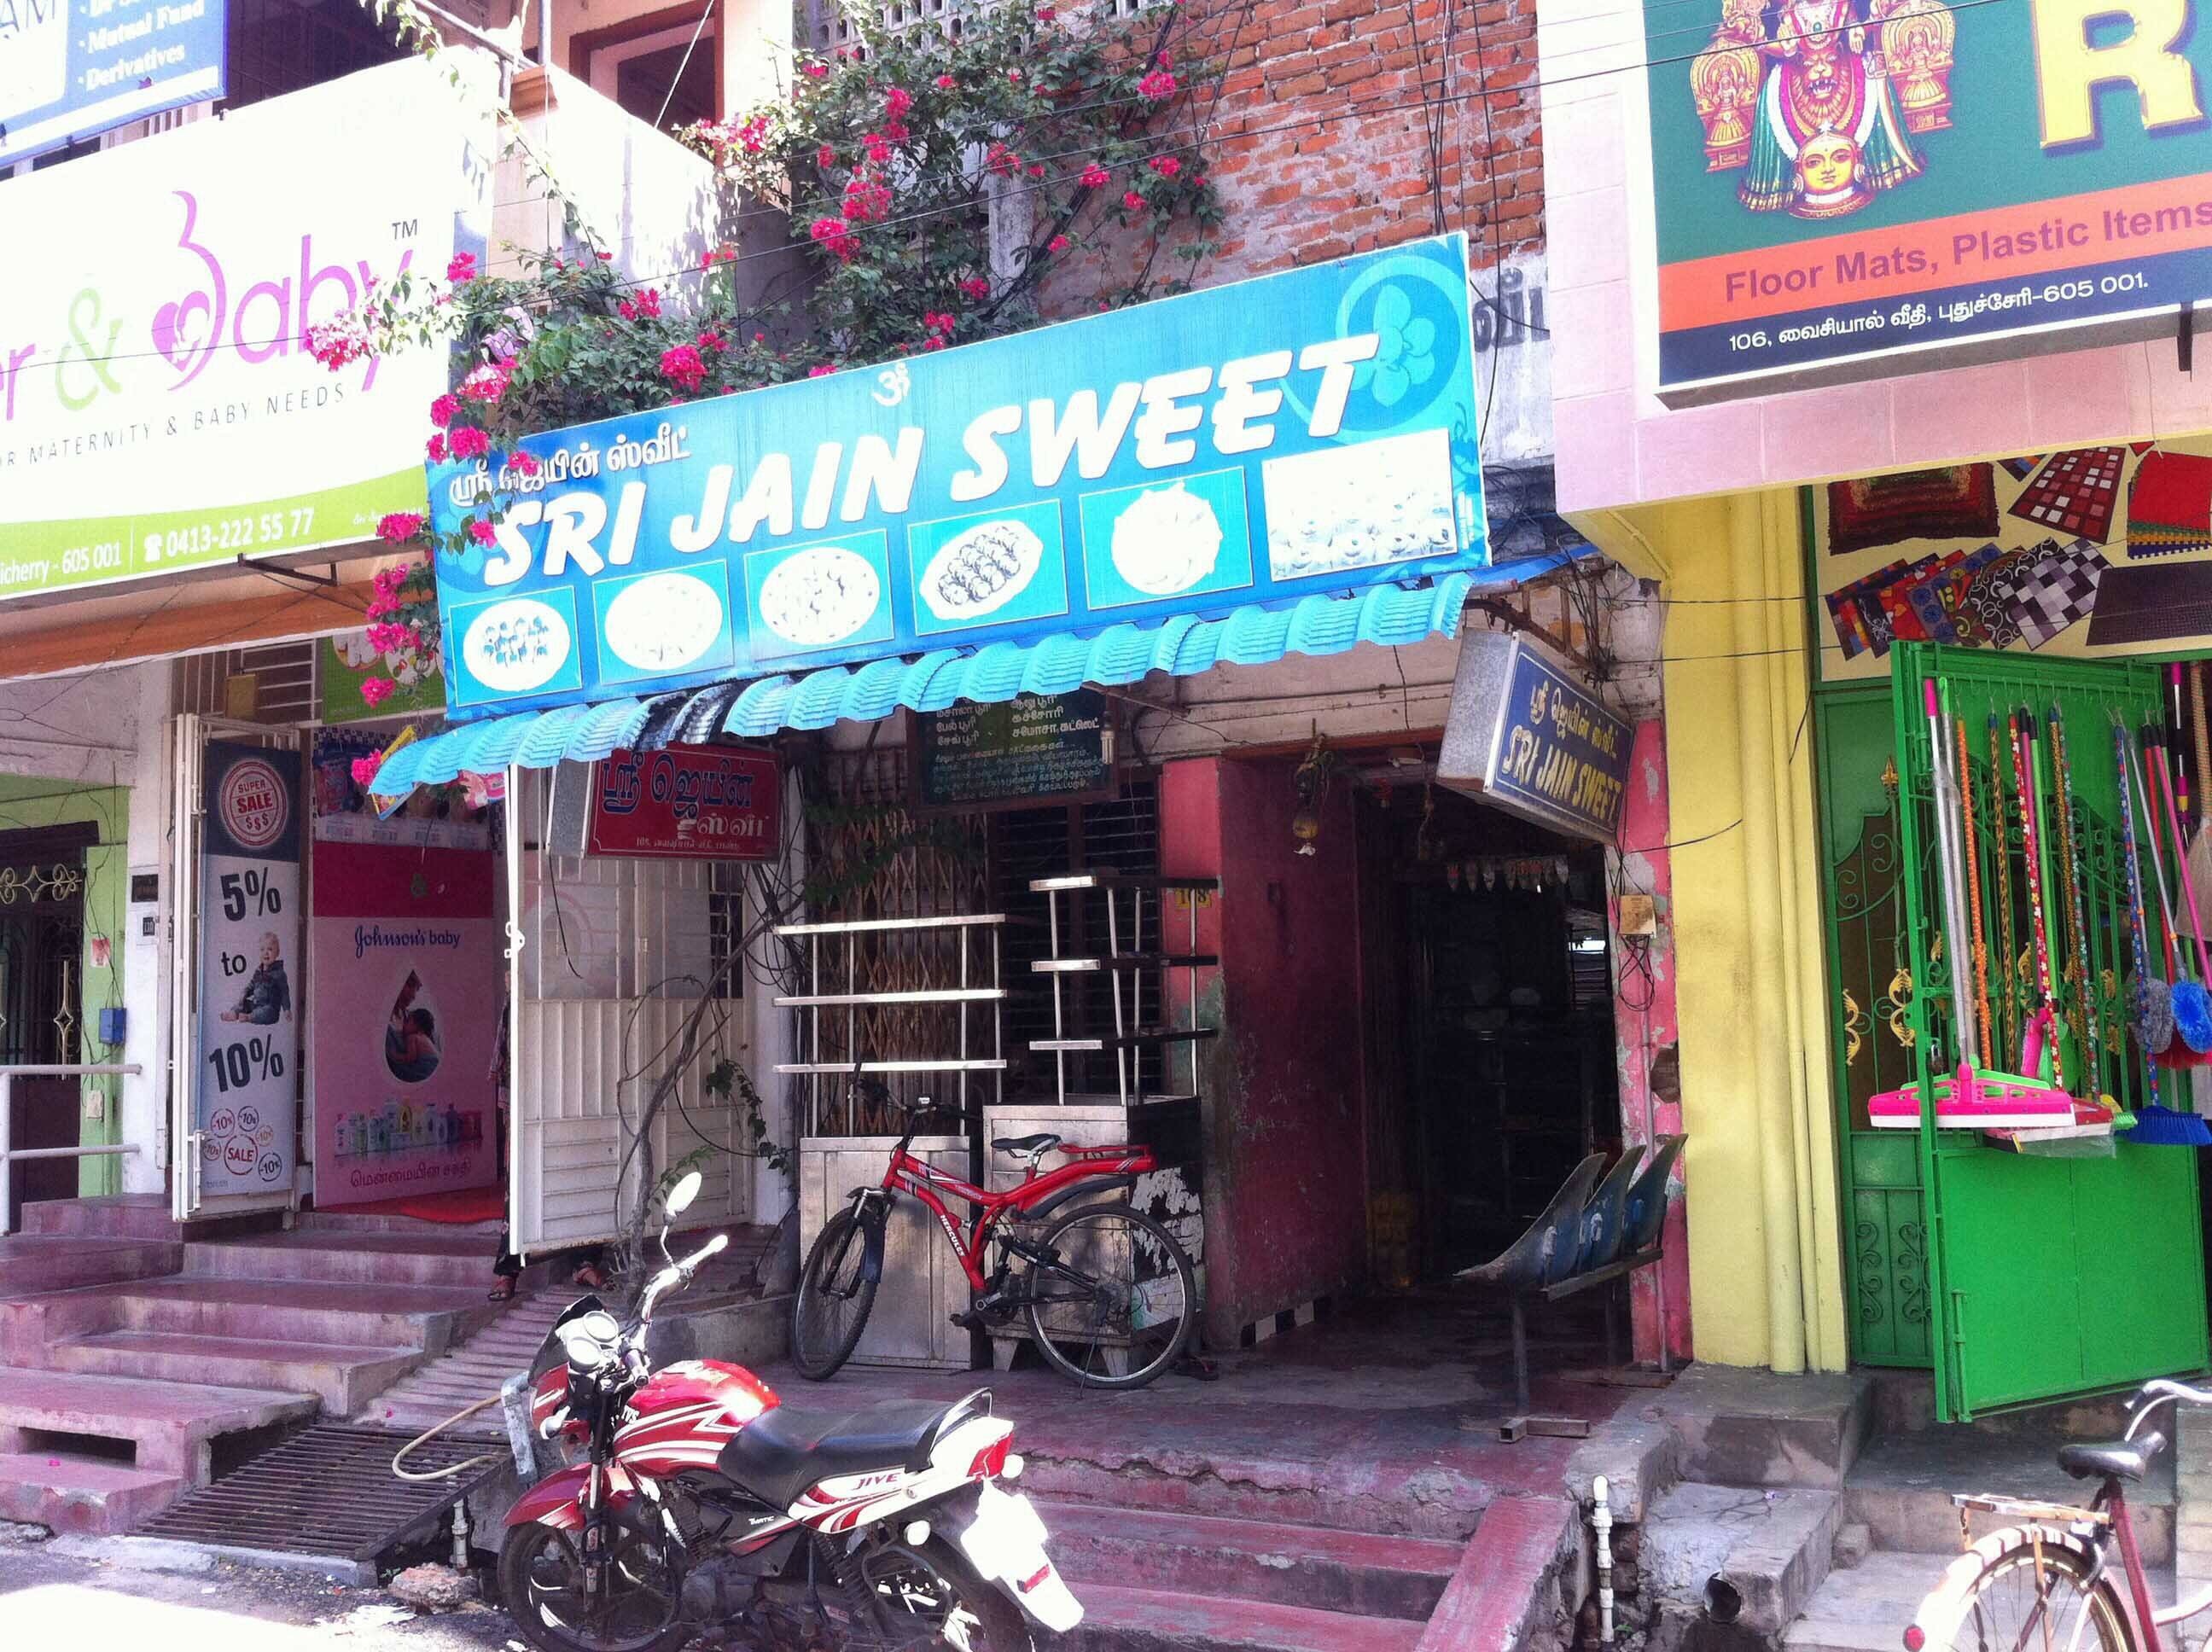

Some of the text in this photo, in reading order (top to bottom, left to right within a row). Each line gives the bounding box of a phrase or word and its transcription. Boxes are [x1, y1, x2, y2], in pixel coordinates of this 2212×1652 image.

[88, 12, 152, 54] Mutual
[157, 0, 205, 29] Fund
[86, 44, 185, 91] Derivatives
[1726, 201, 2212, 302] Floor Mats, Plastic Items
[1729, 330, 1773, 352] 106,
[1778, 310, 1885, 343] வைசியால்
[2100, 272, 2149, 294] 001.
[30, 422, 151, 465] MATERNITY
[166, 416, 178, 435] &
[194, 402, 251, 431] BABY
[266, 383, 344, 416] NEEDS
[484, 333, 1380, 586] SRI JAIN SWEET
[166, 518, 253, 557] 0413-222
[260, 511, 283, 543] 55
[290, 507, 316, 538] 77
[62, 547, 90, 574] 605
[93, 539, 122, 569] 001
[237, 778, 266, 794] SUPER
[1502, 724, 1621, 823] SRI JAIN SWEET
[236, 792, 273, 814] SALE
[220, 866, 282, 922] 5%
[220, 943, 247, 977] to
[354, 925, 461, 959] Johnson's baby
[208, 1033, 284, 1093] 10%
[227, 1147, 254, 1162] SALE
[940, 1213, 966, 1258] HERCULES
[621, 1405, 640, 1425] TVS
[855, 1471, 902, 1490] JIVE
